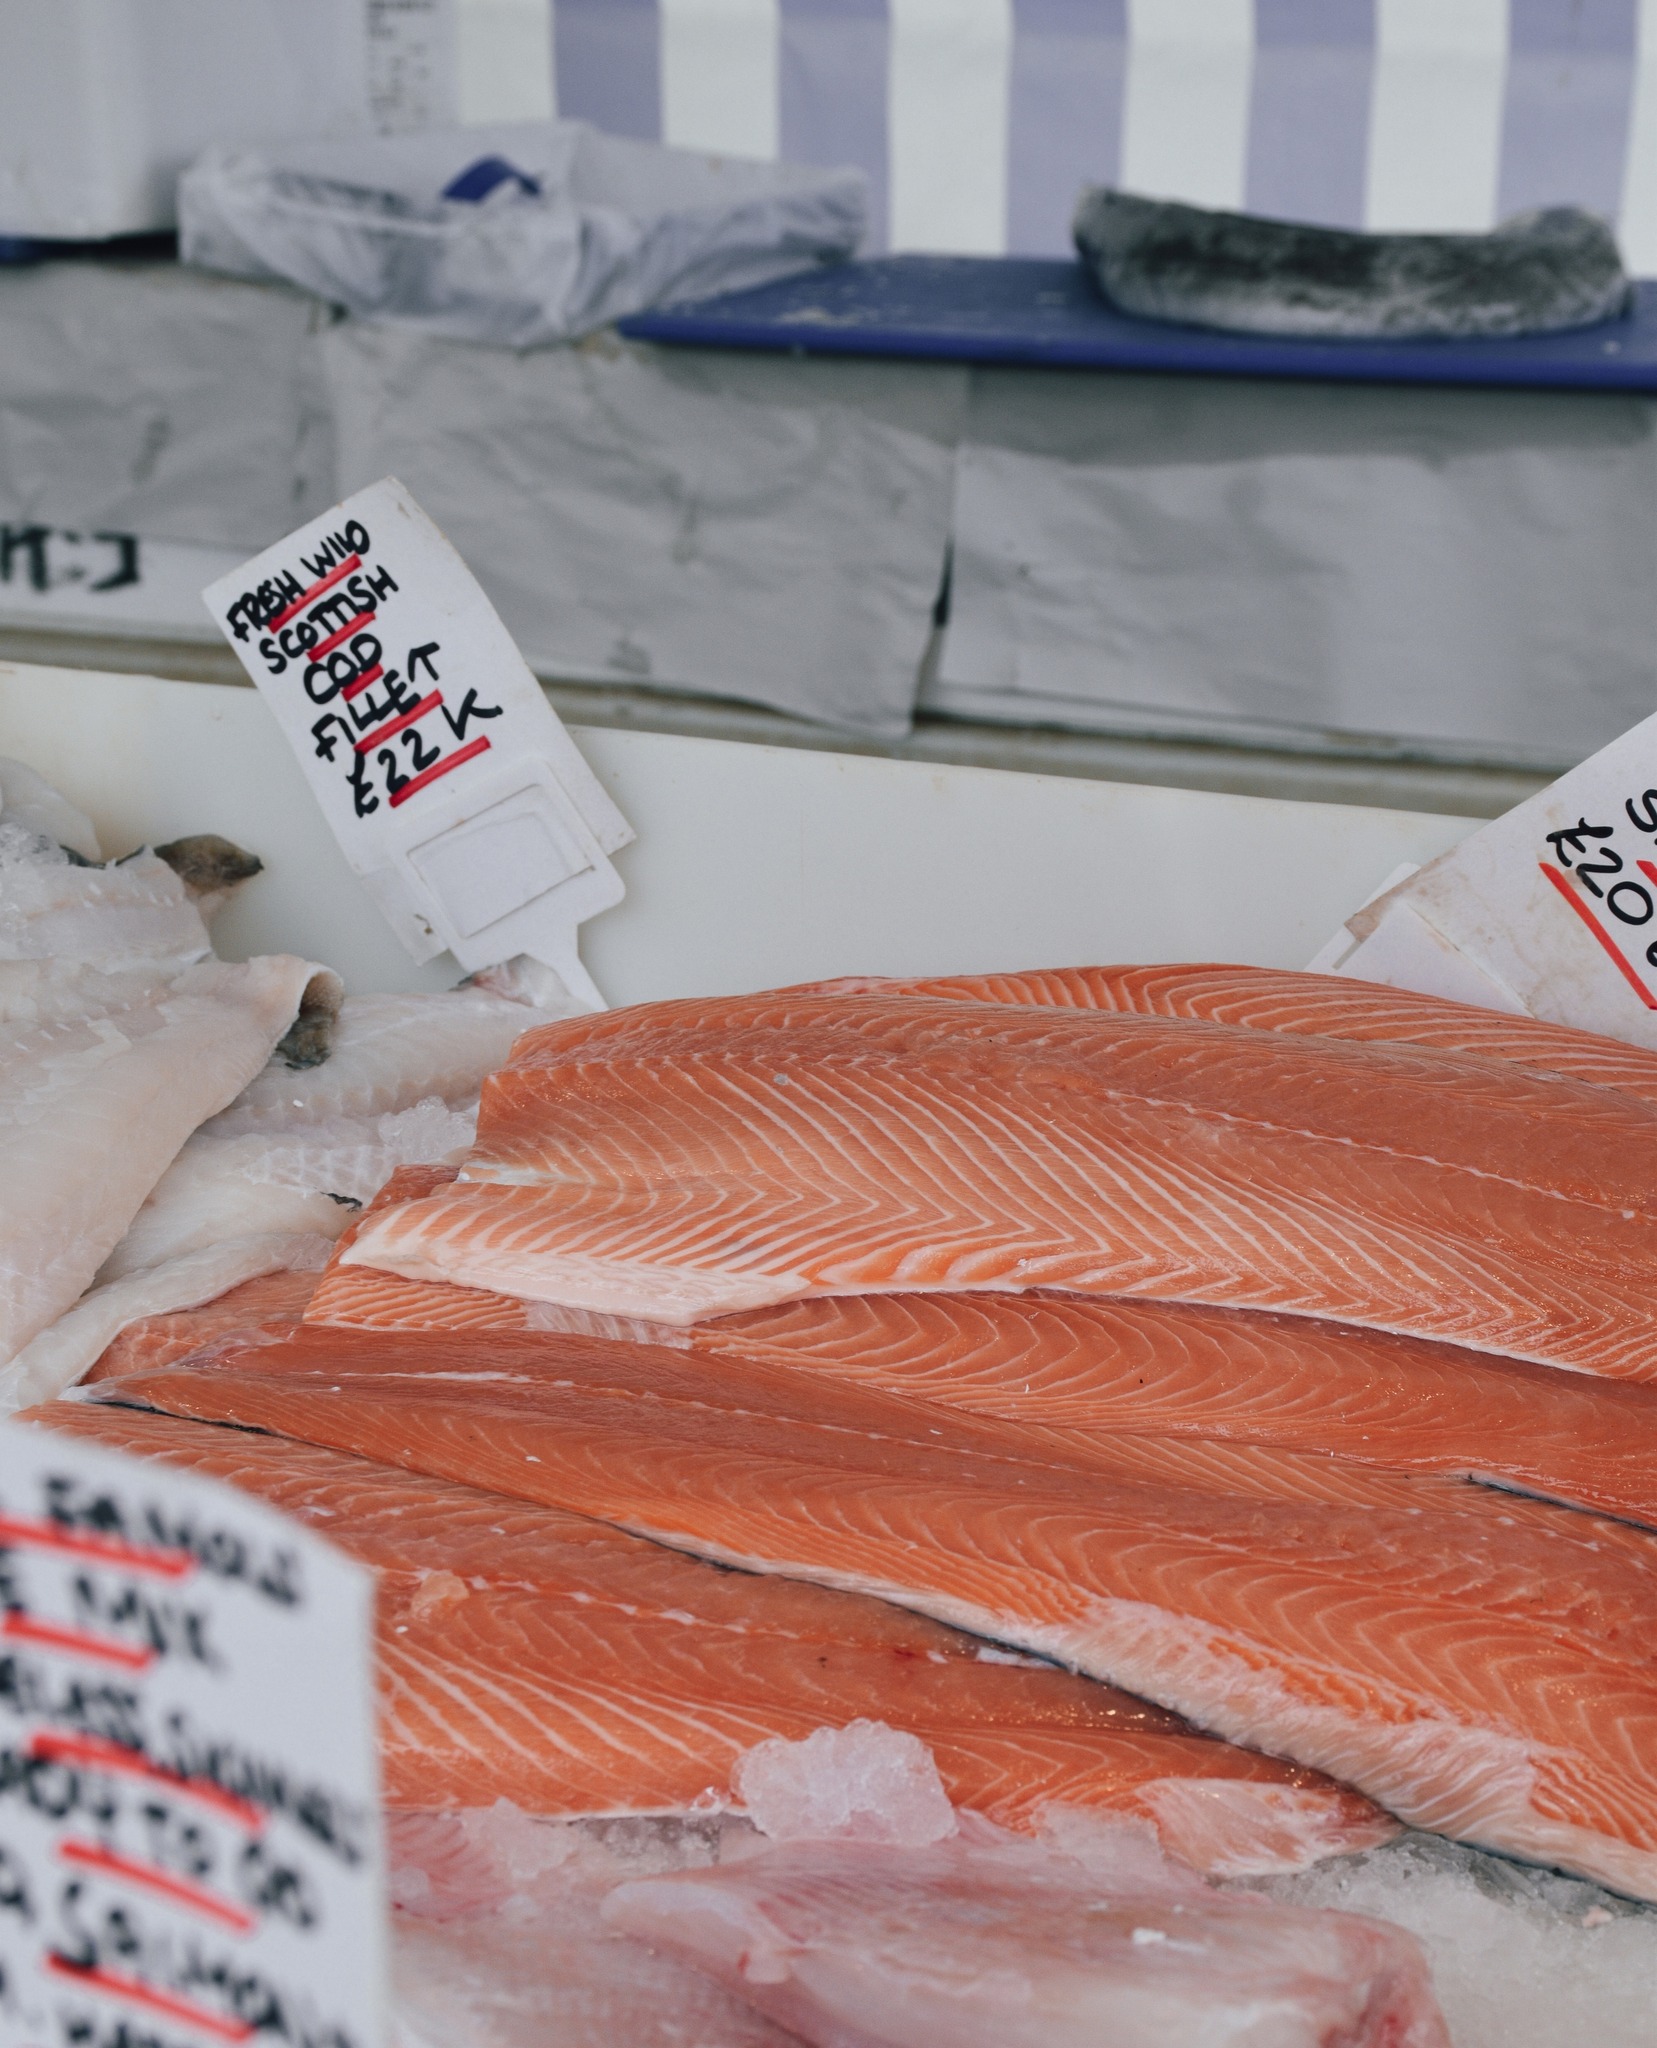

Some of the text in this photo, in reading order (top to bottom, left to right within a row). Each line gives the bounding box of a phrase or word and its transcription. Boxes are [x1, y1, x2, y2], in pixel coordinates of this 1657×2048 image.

[227, 519, 371, 643] FRESH WILD
[258, 564, 399, 675] SCOTTISH
[303, 632, 383, 705] COD
[310, 641, 441, 763] FILLET
[345, 687, 504, 819] £22 K
[1545, 816, 1654, 926] £20
